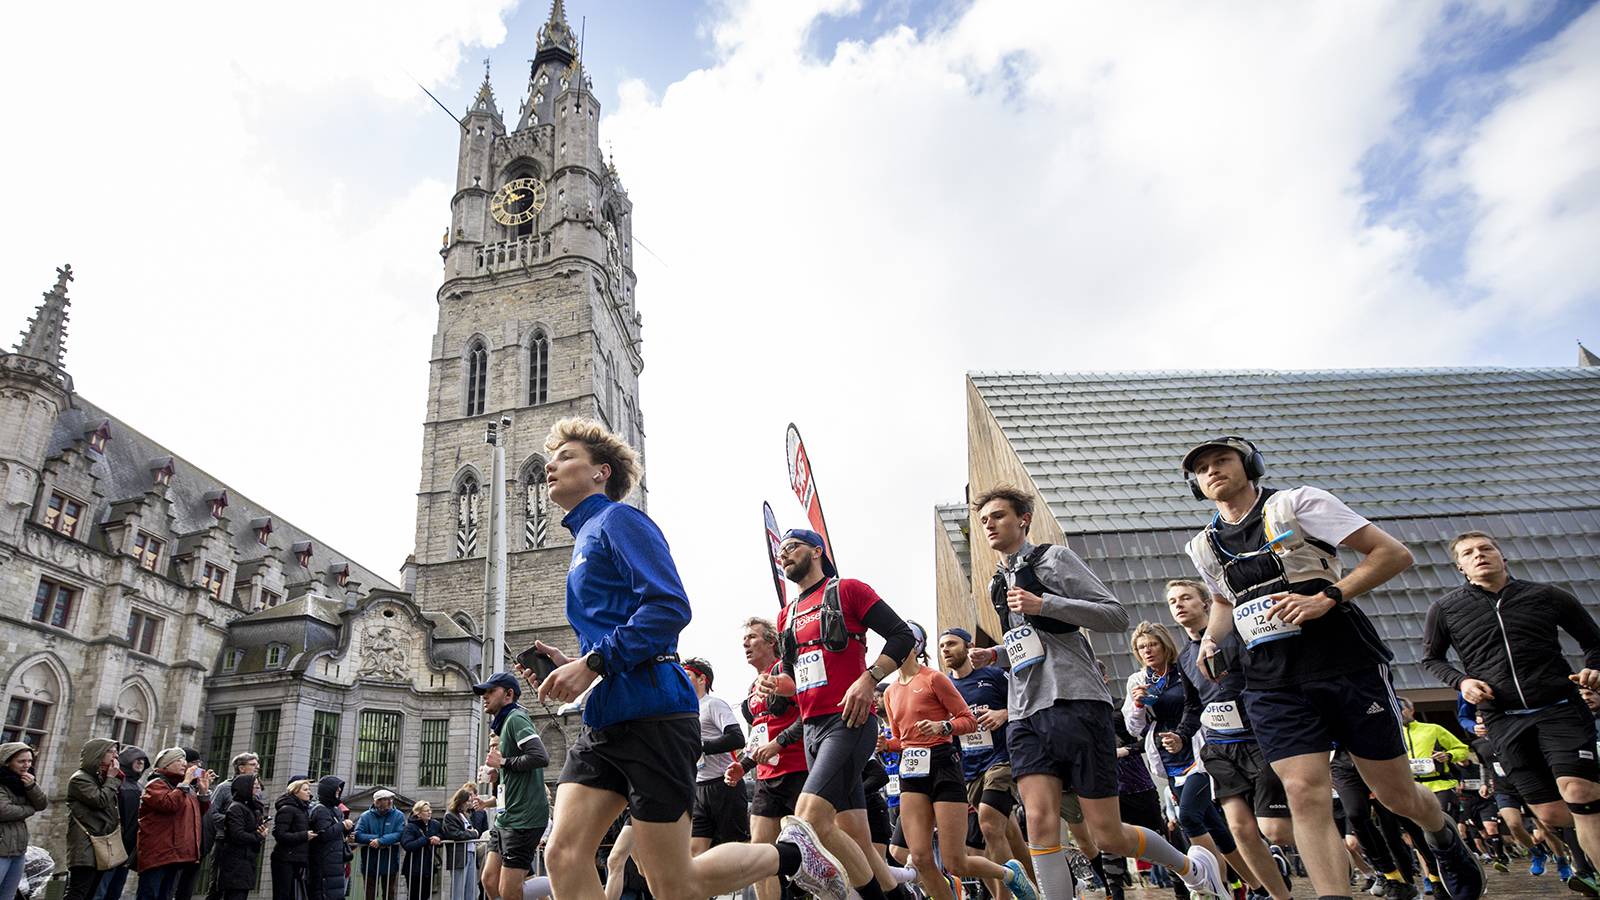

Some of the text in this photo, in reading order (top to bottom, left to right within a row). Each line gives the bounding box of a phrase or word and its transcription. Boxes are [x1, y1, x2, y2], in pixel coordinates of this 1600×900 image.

[1236, 599, 1277, 620] SOFIC
[1004, 628, 1032, 647] FICO
[1250, 623, 1277, 636] Winok
